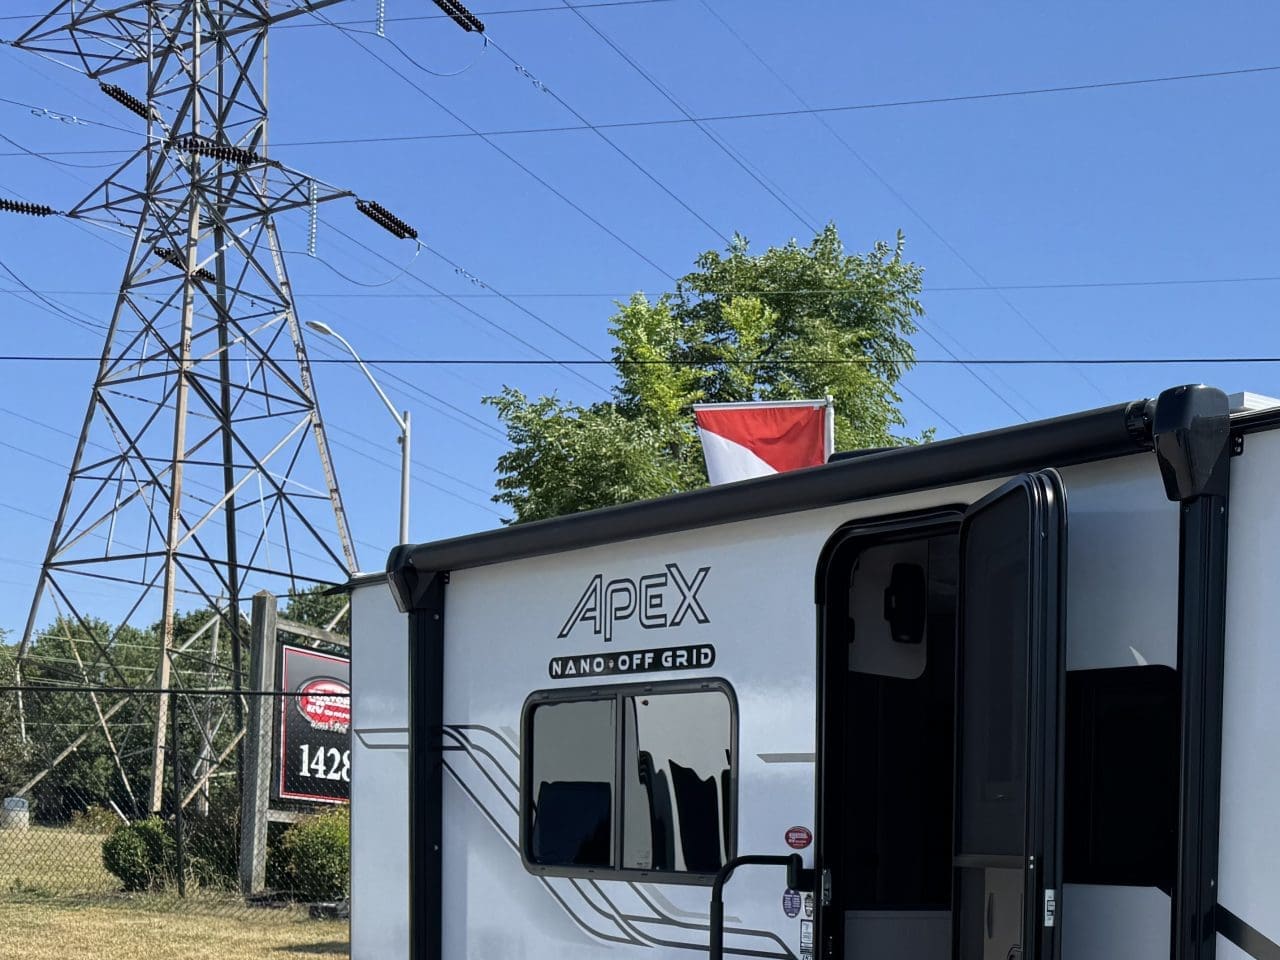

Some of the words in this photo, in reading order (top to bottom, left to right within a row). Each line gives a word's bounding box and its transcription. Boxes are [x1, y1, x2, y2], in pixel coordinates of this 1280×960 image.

[552, 657, 605, 676] NANO
[618, 653, 655, 671] OFF
[661, 648, 712, 667] GRID
